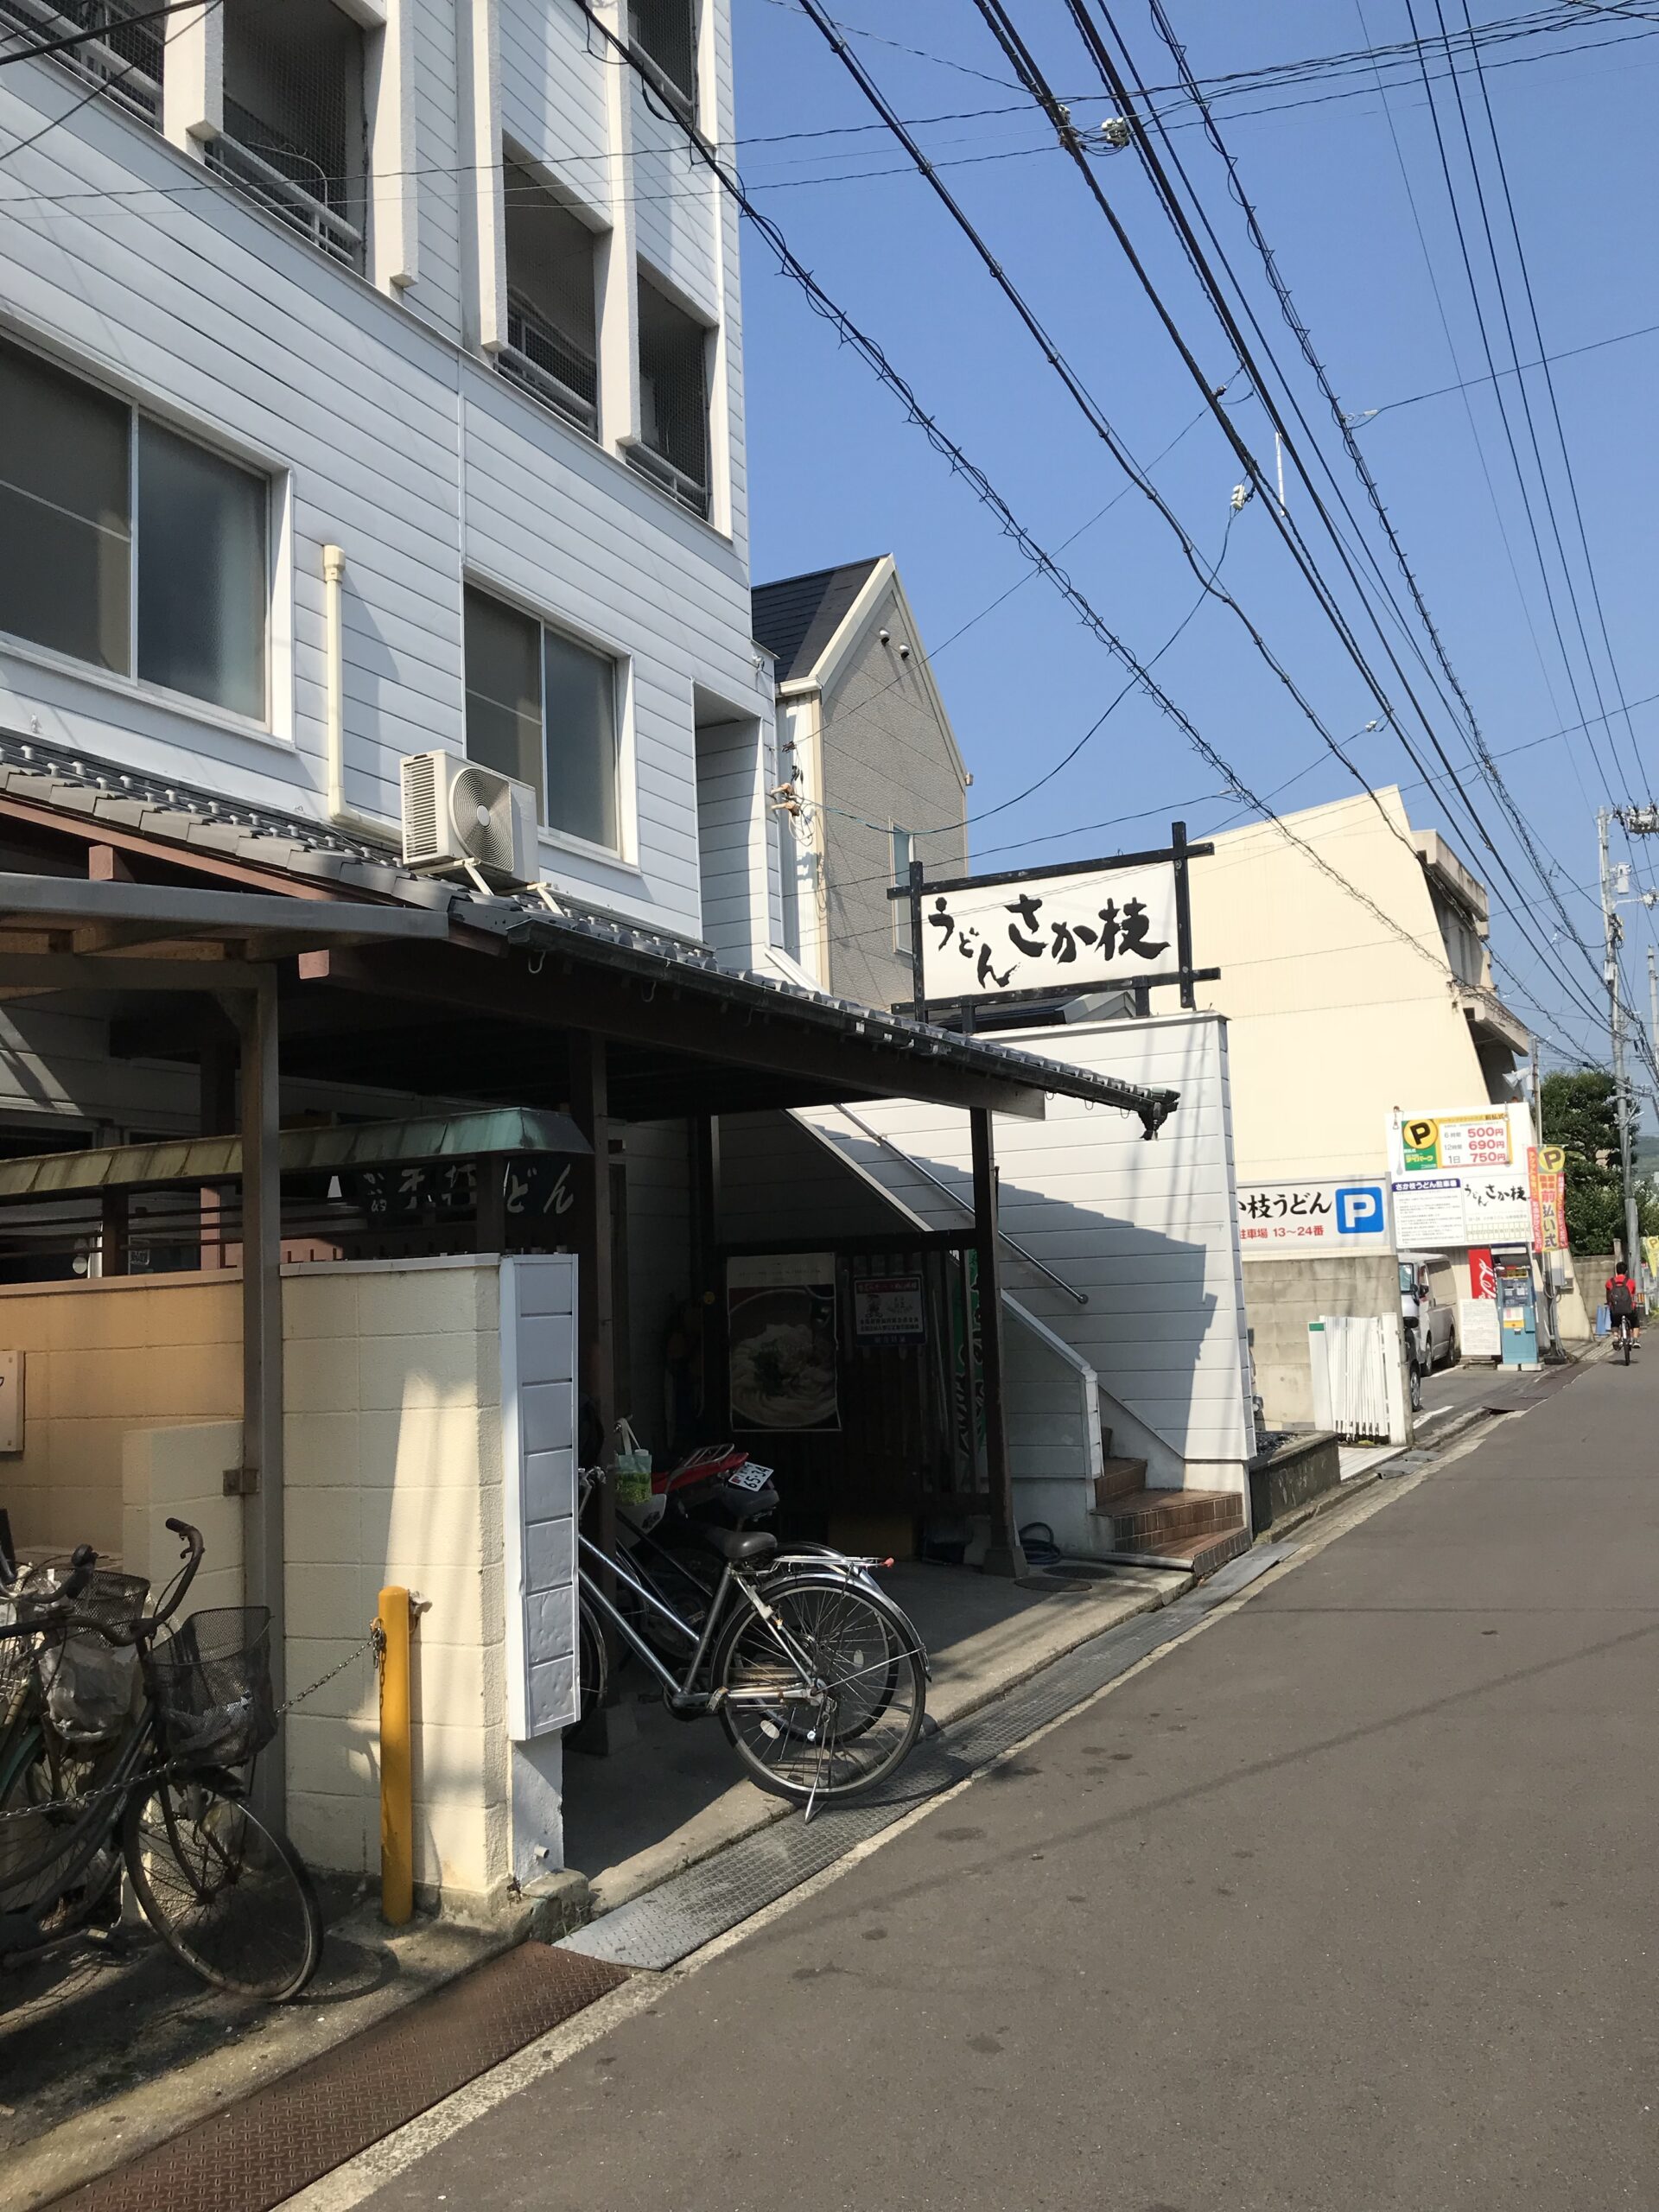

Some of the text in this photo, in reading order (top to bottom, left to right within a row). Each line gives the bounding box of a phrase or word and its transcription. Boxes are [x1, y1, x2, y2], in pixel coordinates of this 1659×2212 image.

[928, 893, 1172, 988] うどん さか枝
[1409, 1122, 1431, 1146] P
[1467, 1127, 1503, 1138] 500円
[1468, 1140, 1505, 1150] 690円
[1448, 1152, 1506, 1164] 1日 750円
[1543, 1149, 1561, 1170] P
[1465, 1183, 1532, 1206] うどん さか枝
[1344, 1193, 1376, 1228] P
[1541, 1191, 1557, 1248] 前払い式
